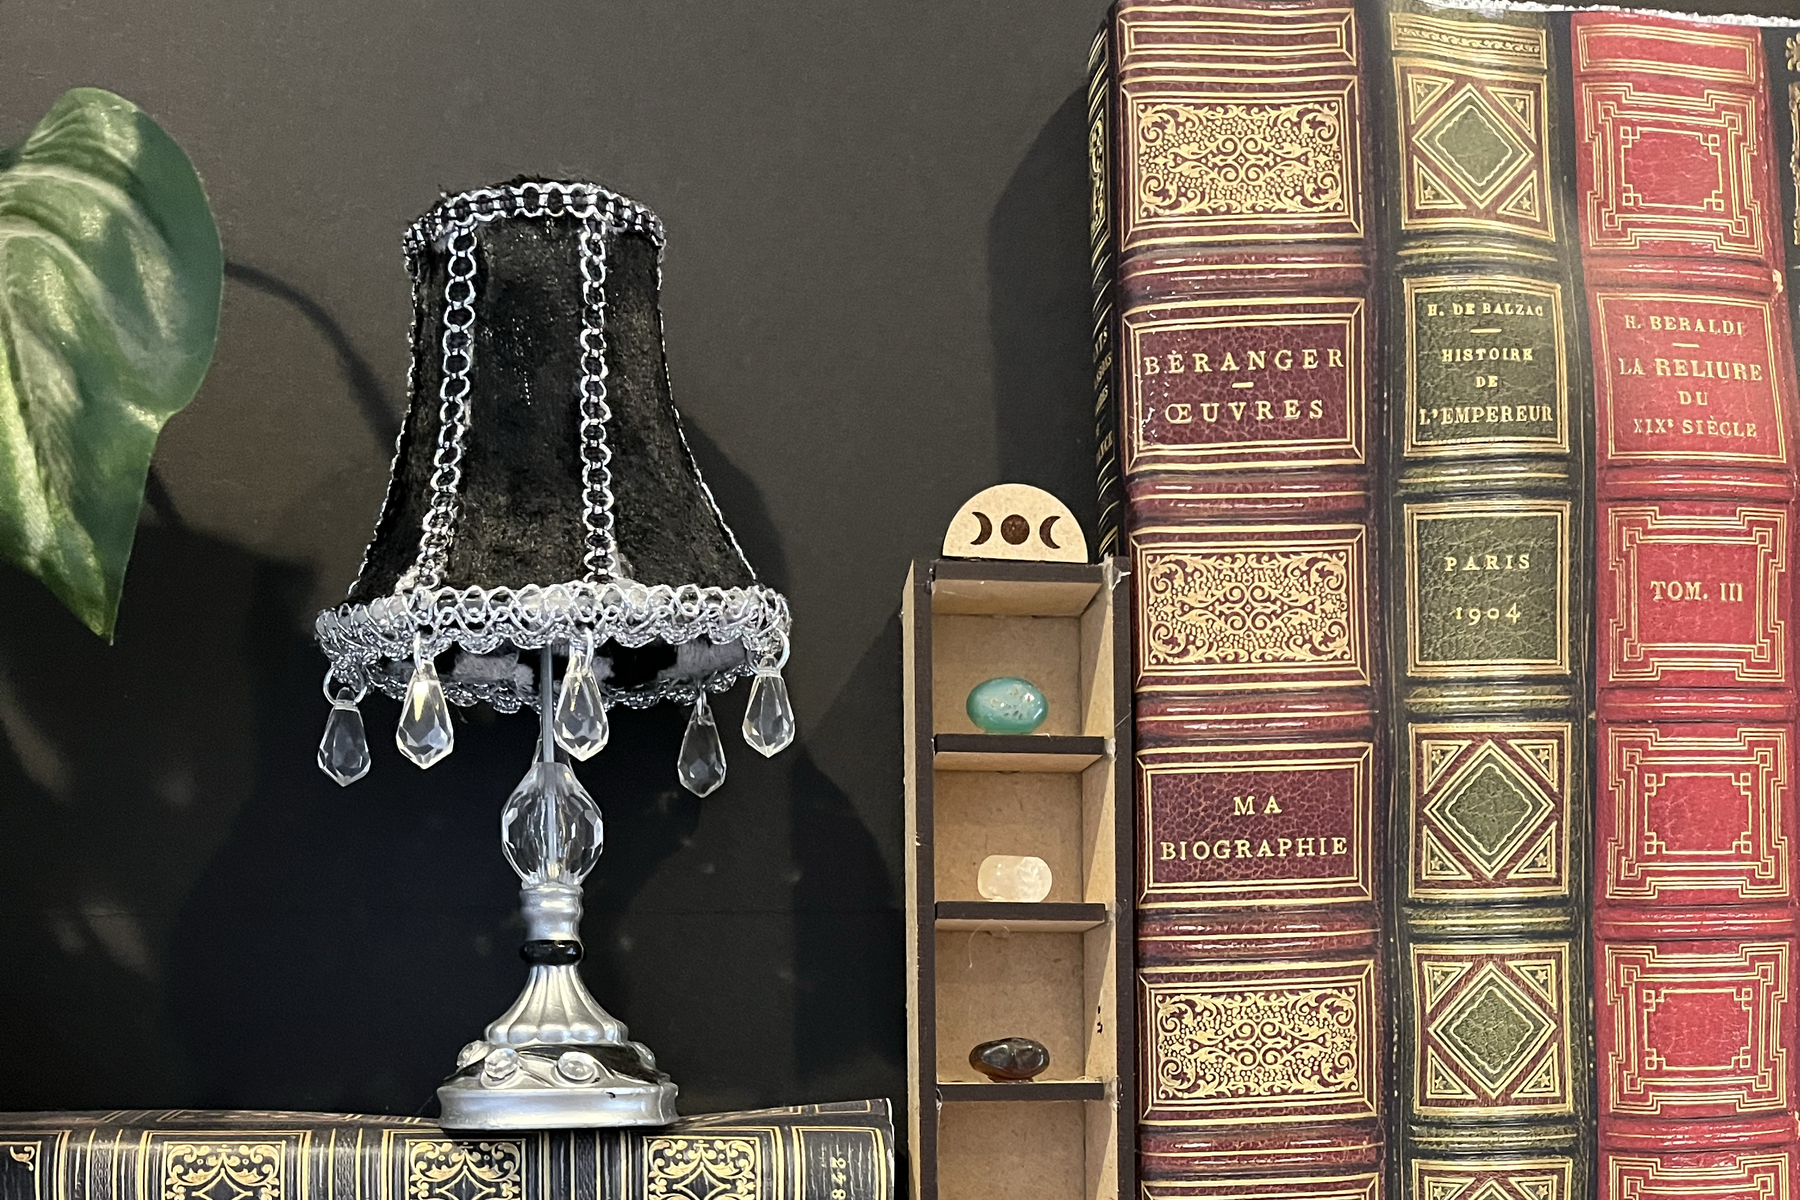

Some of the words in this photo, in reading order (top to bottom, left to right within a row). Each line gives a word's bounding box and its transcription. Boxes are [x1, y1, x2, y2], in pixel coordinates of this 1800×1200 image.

[1428, 303, 1445, 317] H.
[1452, 302, 1476, 316] DE
[1482, 302, 1544, 317] BALZAC
[1624, 314, 1642, 330] H.
[1649, 315, 1744, 336] BERALDI
[1441, 347, 1533, 363] HISTOIRE
[1618, 357, 1646, 376] LA
[1654, 357, 1763, 381] RELIURE
[1475, 375, 1499, 388] DE
[1678, 390, 1709, 406] DU
[1164, 399, 1324, 424] ŒUVRES
[1418, 404, 1554, 426] L'EMPEREUR
[1682, 415, 1757, 438] SIÈCLE
[1444, 553, 1531, 573] PARIS
[1650, 580, 1709, 601] TOM.
[1719, 582, 1744, 602] III
[1455, 602, 1522, 626] 1904
[1232, 794, 1284, 816] MA
[1160, 836, 1349, 861] BIOGRAPHIE
